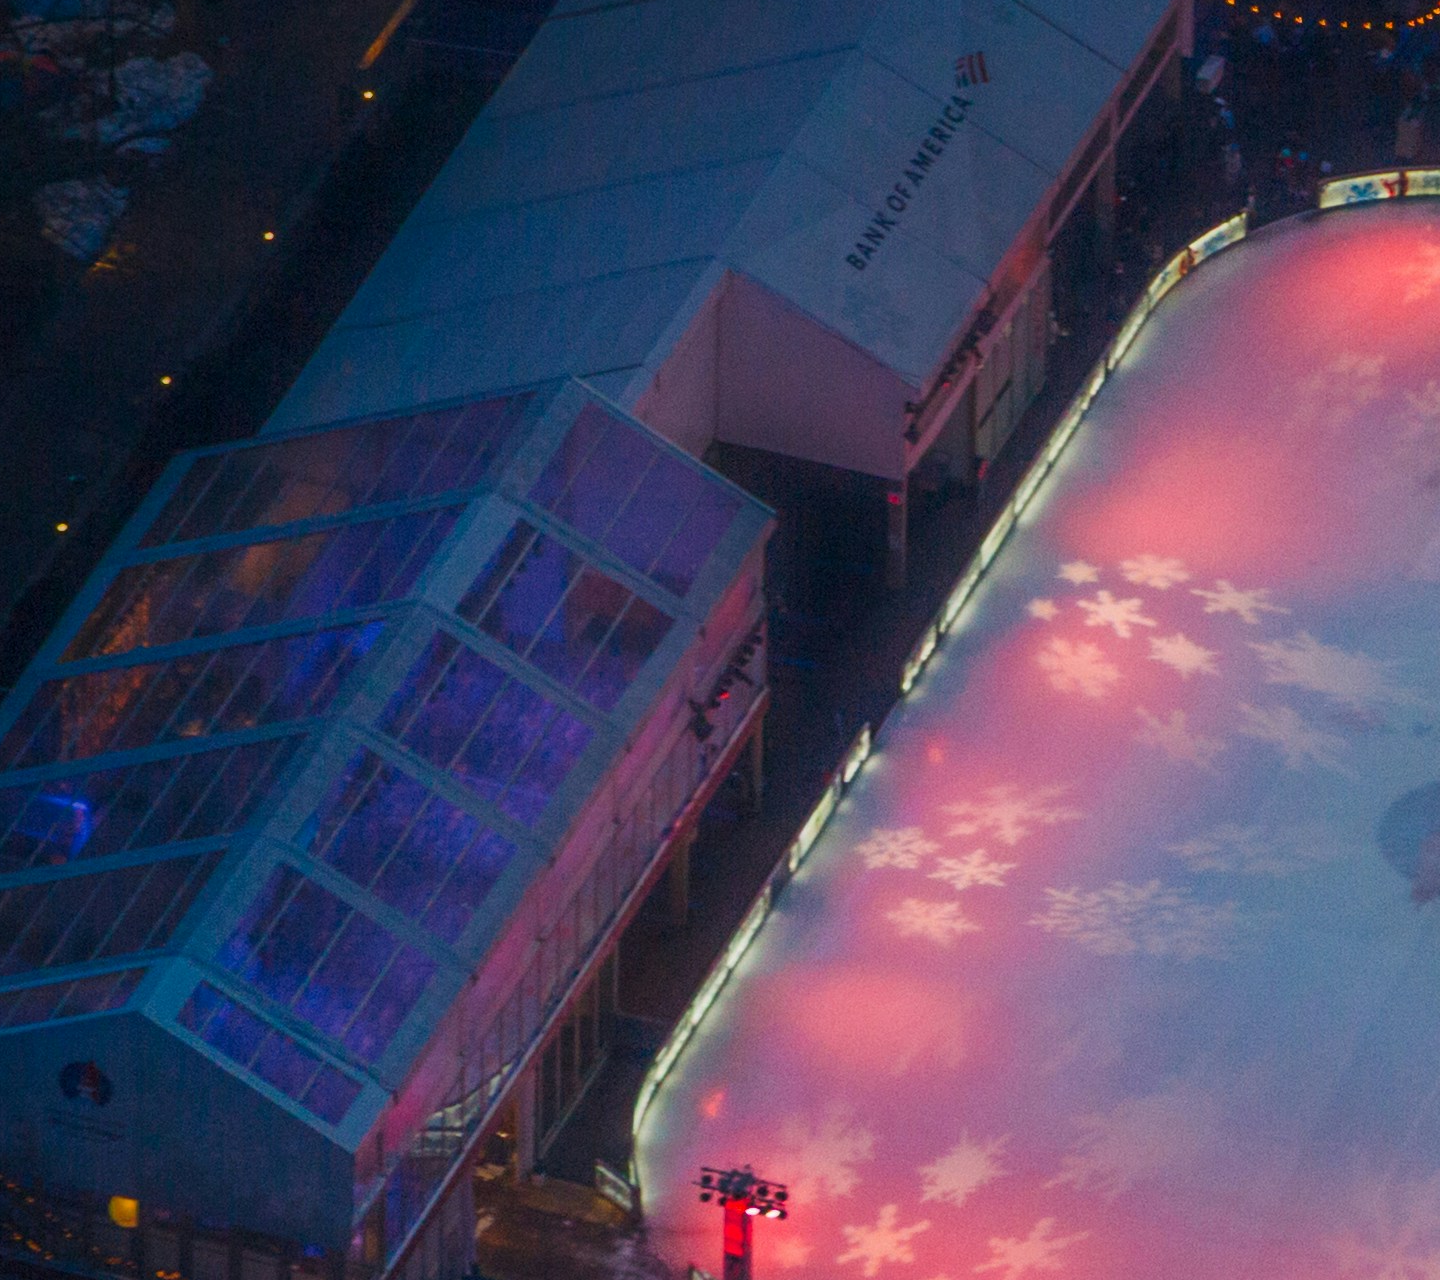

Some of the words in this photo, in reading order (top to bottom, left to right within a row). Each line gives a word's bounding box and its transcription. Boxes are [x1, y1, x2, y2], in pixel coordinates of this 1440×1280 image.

[845, 211, 896, 271] BANK
[886, 182, 912, 214] OF
[903, 95, 973, 189] AMERICA
